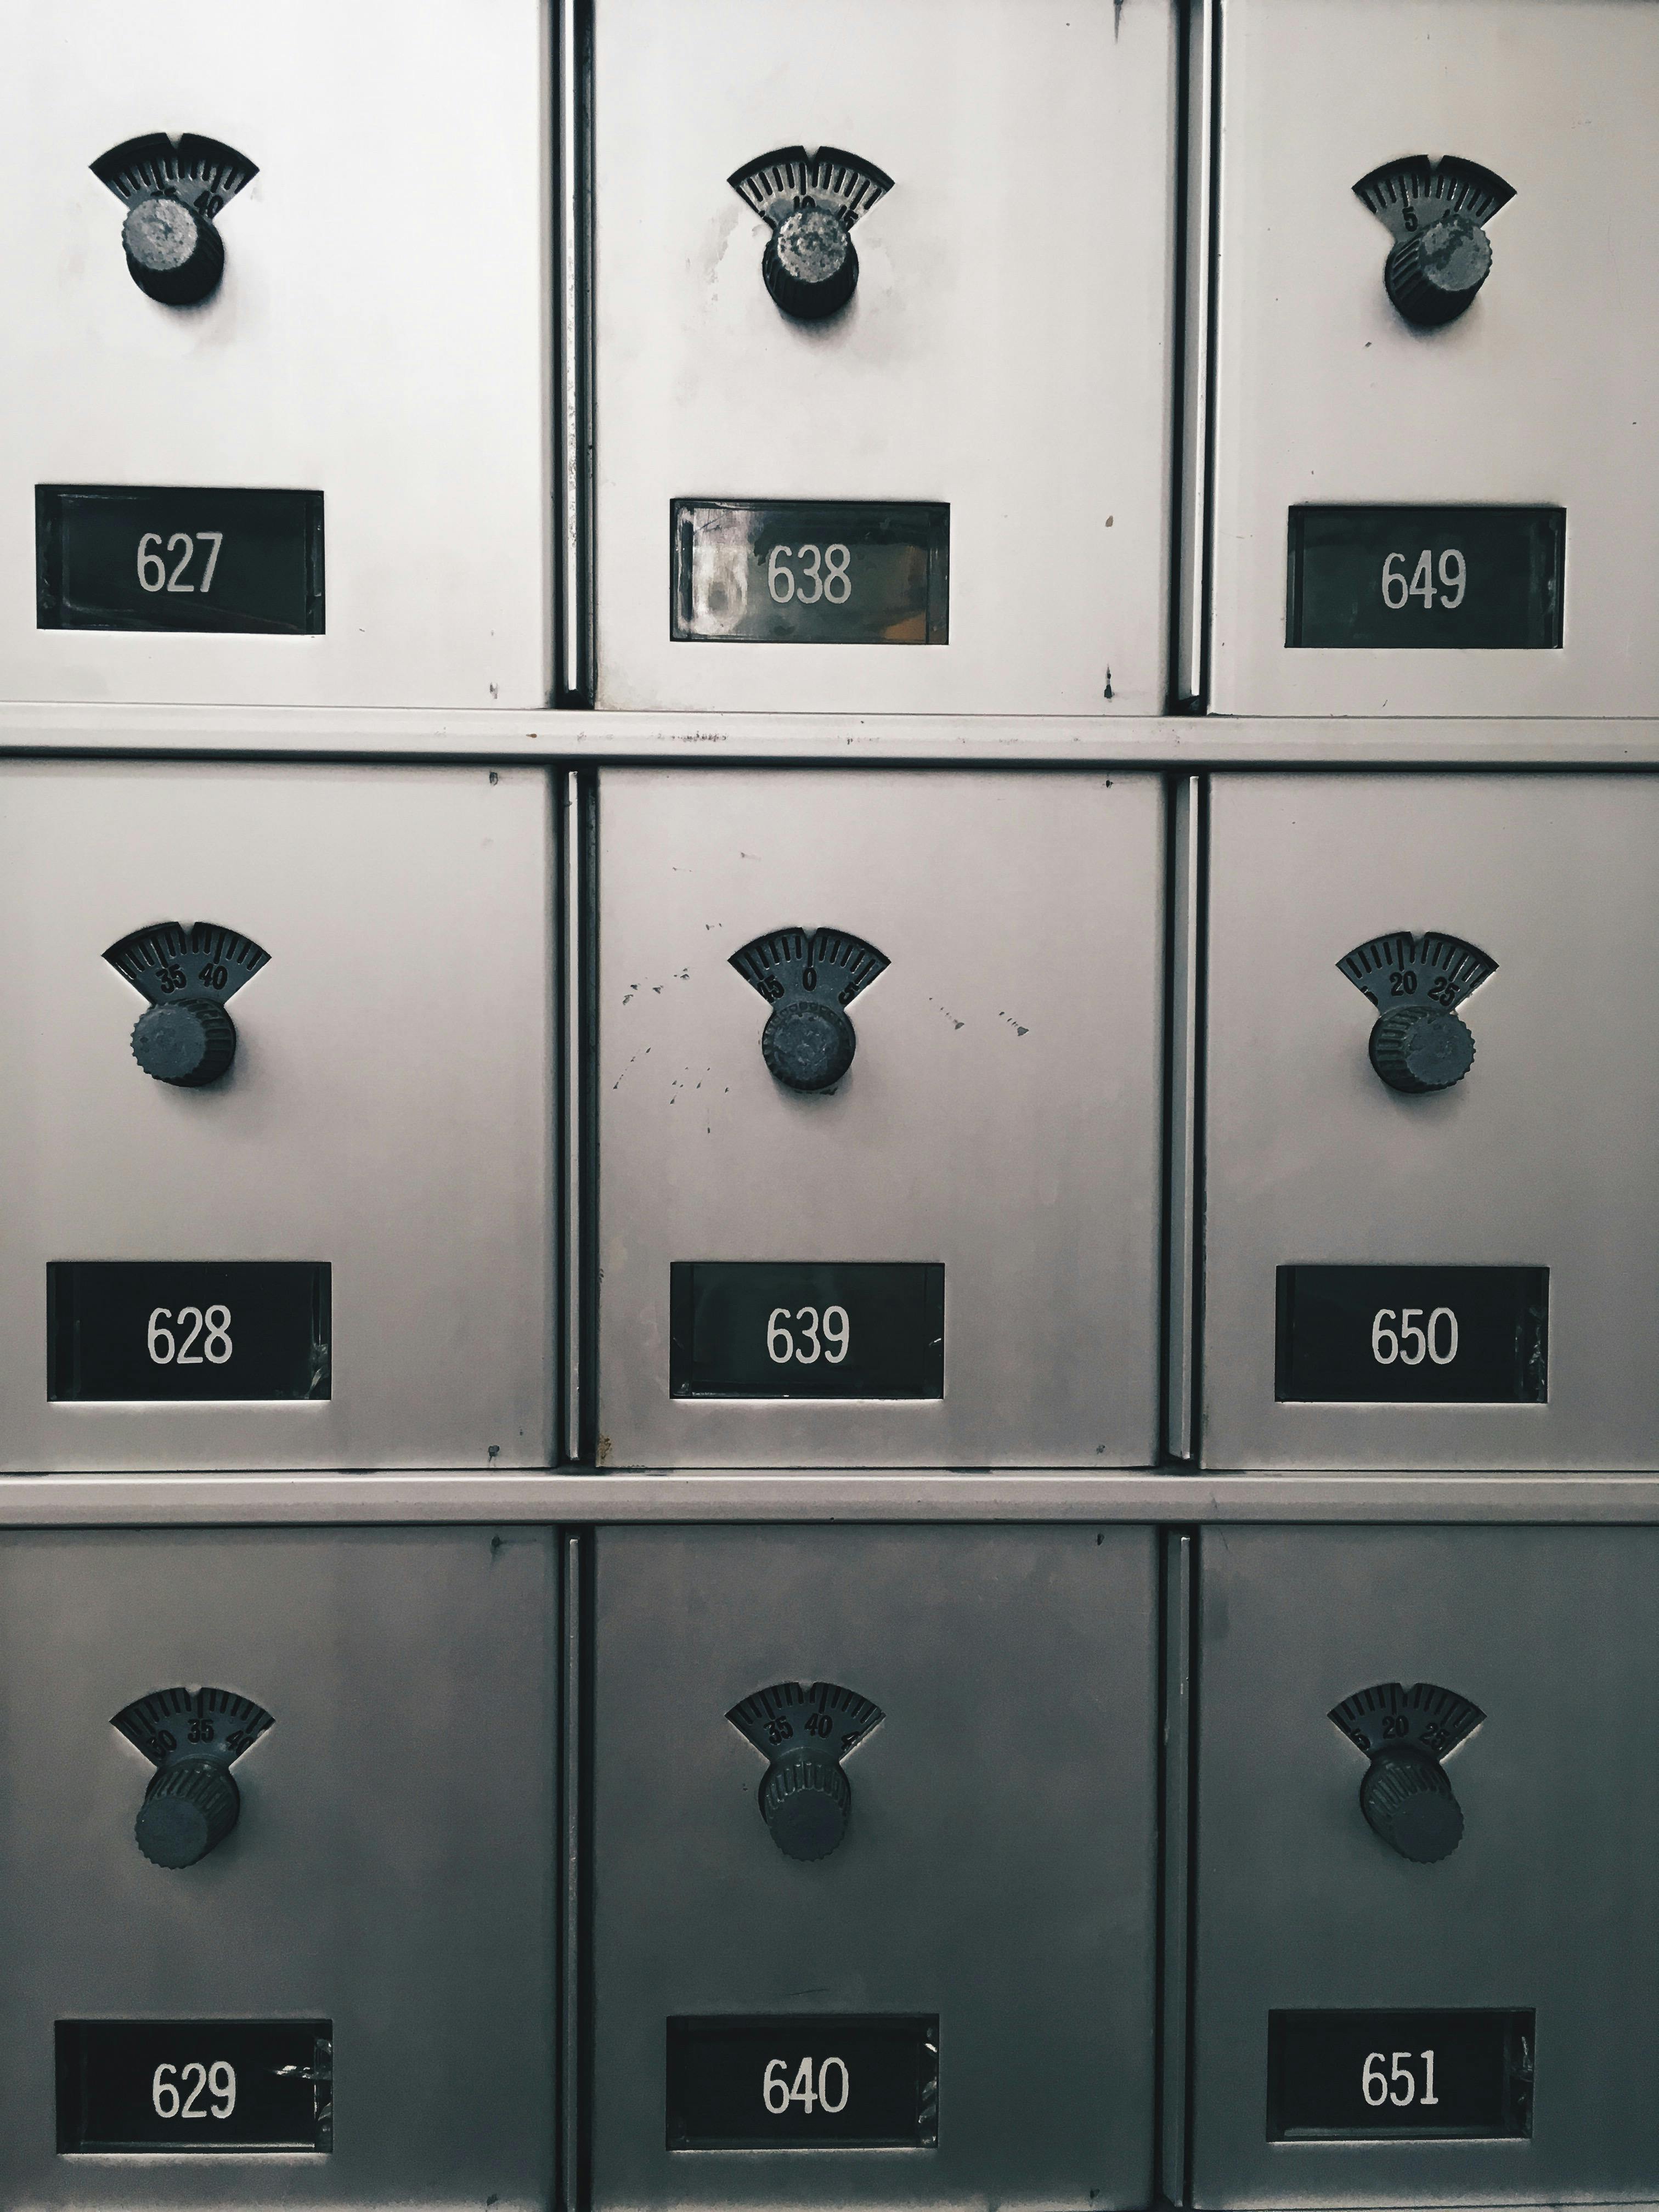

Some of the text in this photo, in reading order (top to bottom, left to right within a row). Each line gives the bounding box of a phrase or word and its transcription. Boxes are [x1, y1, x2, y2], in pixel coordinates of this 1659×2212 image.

[1402, 206, 1418, 232] 5
[138, 533, 223, 592] 627
[768, 544, 851, 604] 638
[1382, 549, 1466, 609] 649
[155, 963, 187, 994] 35
[198, 962, 228, 990] 40
[802, 967, 817, 992] 0
[1389, 970, 1418, 997] 20
[838, 982, 860, 1006] 5
[1427, 977, 1460, 1007] 25
[148, 1305, 233, 1364] 628
[768, 1306, 850, 1364] 639
[1372, 1307, 1458, 1365] 650
[188, 1718, 214, 1743] 35
[763, 1716, 794, 1746] 35
[804, 1713, 833, 1739] 40
[1381, 1715, 1409, 1739] 20
[1418, 1723, 1451, 1752] 25
[153, 2061, 236, 2119] 629
[763, 2057, 849, 2114] 640
[1362, 2050, 1438, 2107] 651
